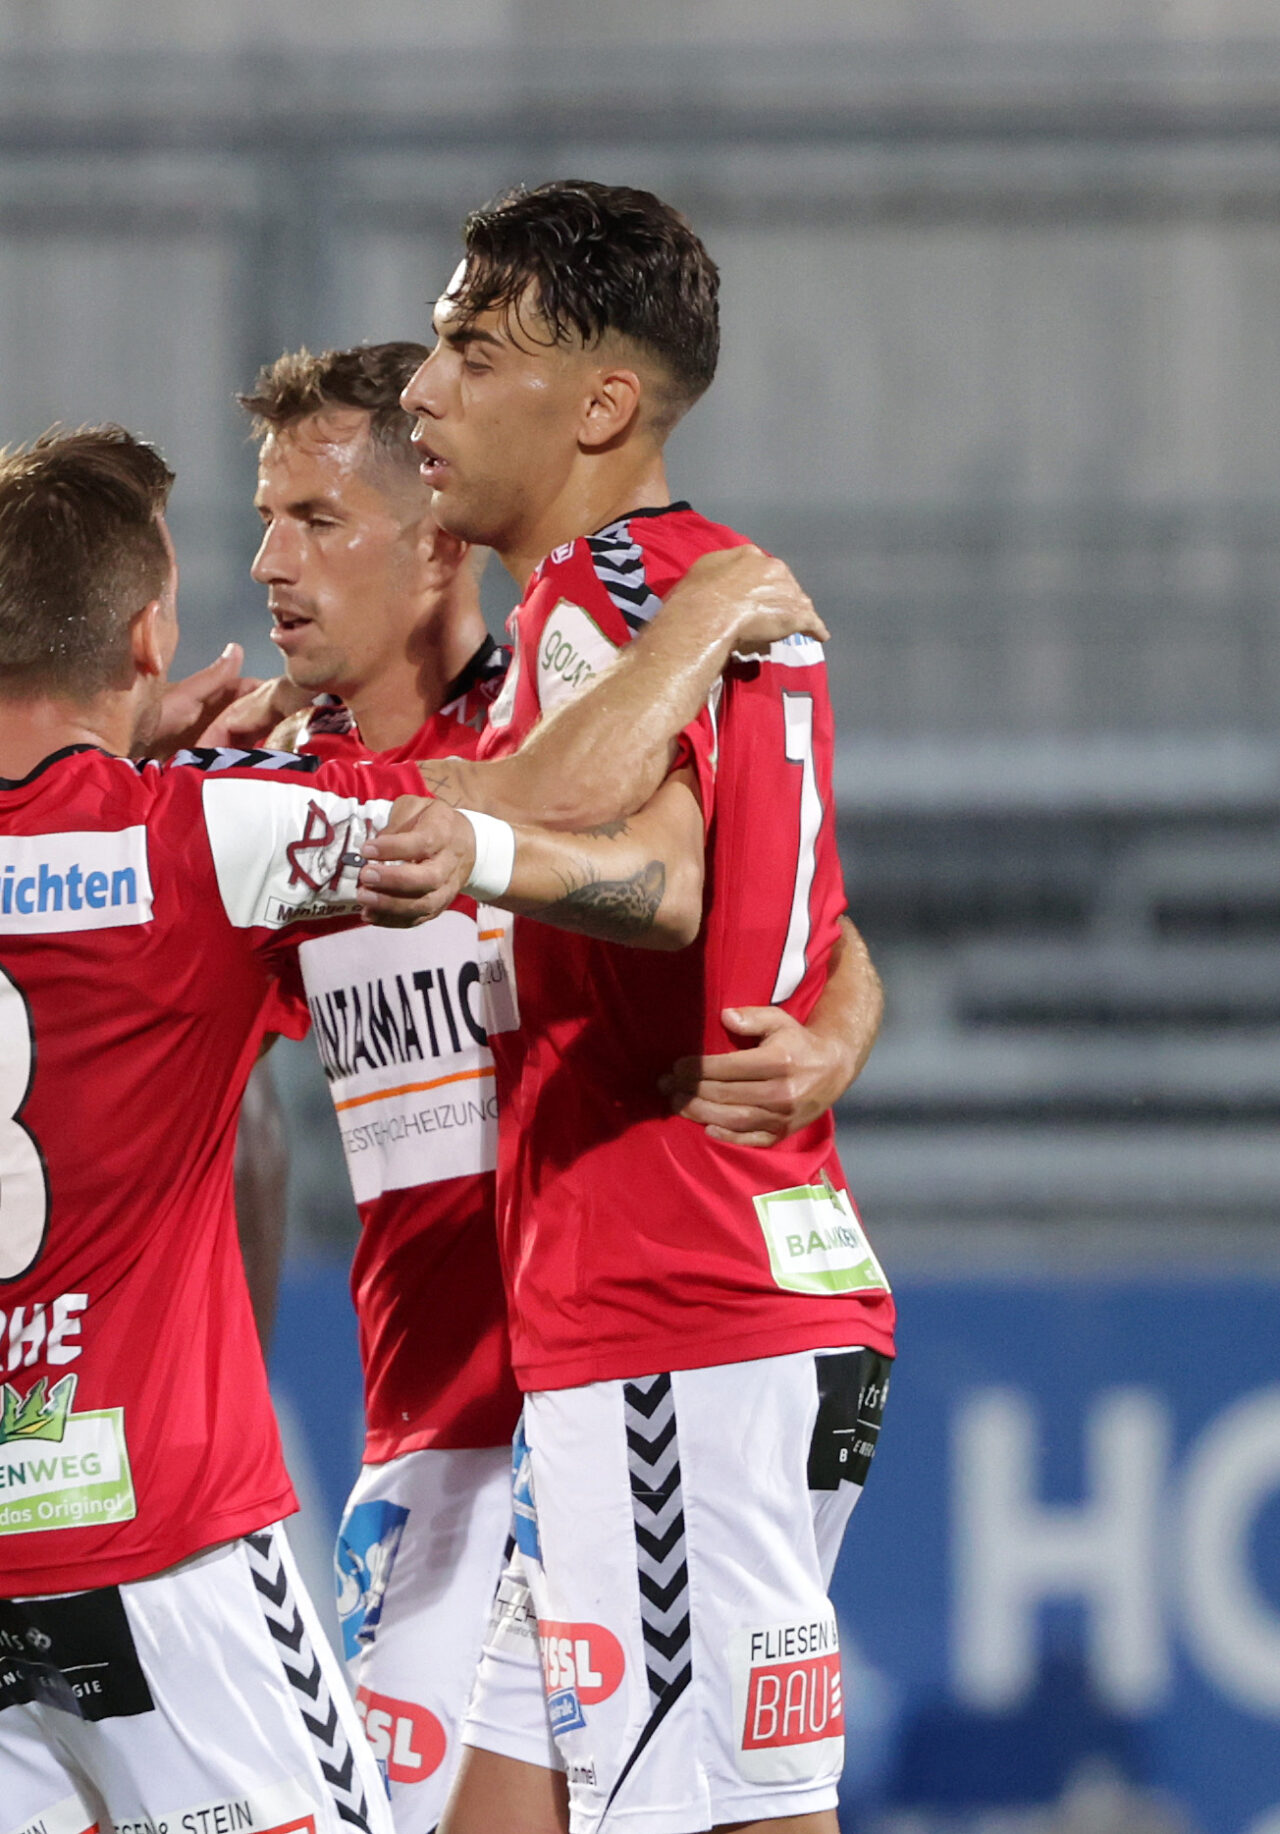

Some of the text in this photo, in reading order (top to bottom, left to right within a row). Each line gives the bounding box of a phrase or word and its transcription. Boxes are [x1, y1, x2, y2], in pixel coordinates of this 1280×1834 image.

[38, 1494, 121, 1520] Original
[751, 1620, 829, 1661] FLIESEN
[752, 1666, 829, 1740] BAU
[181, 1800, 254, 1834] STEIN
